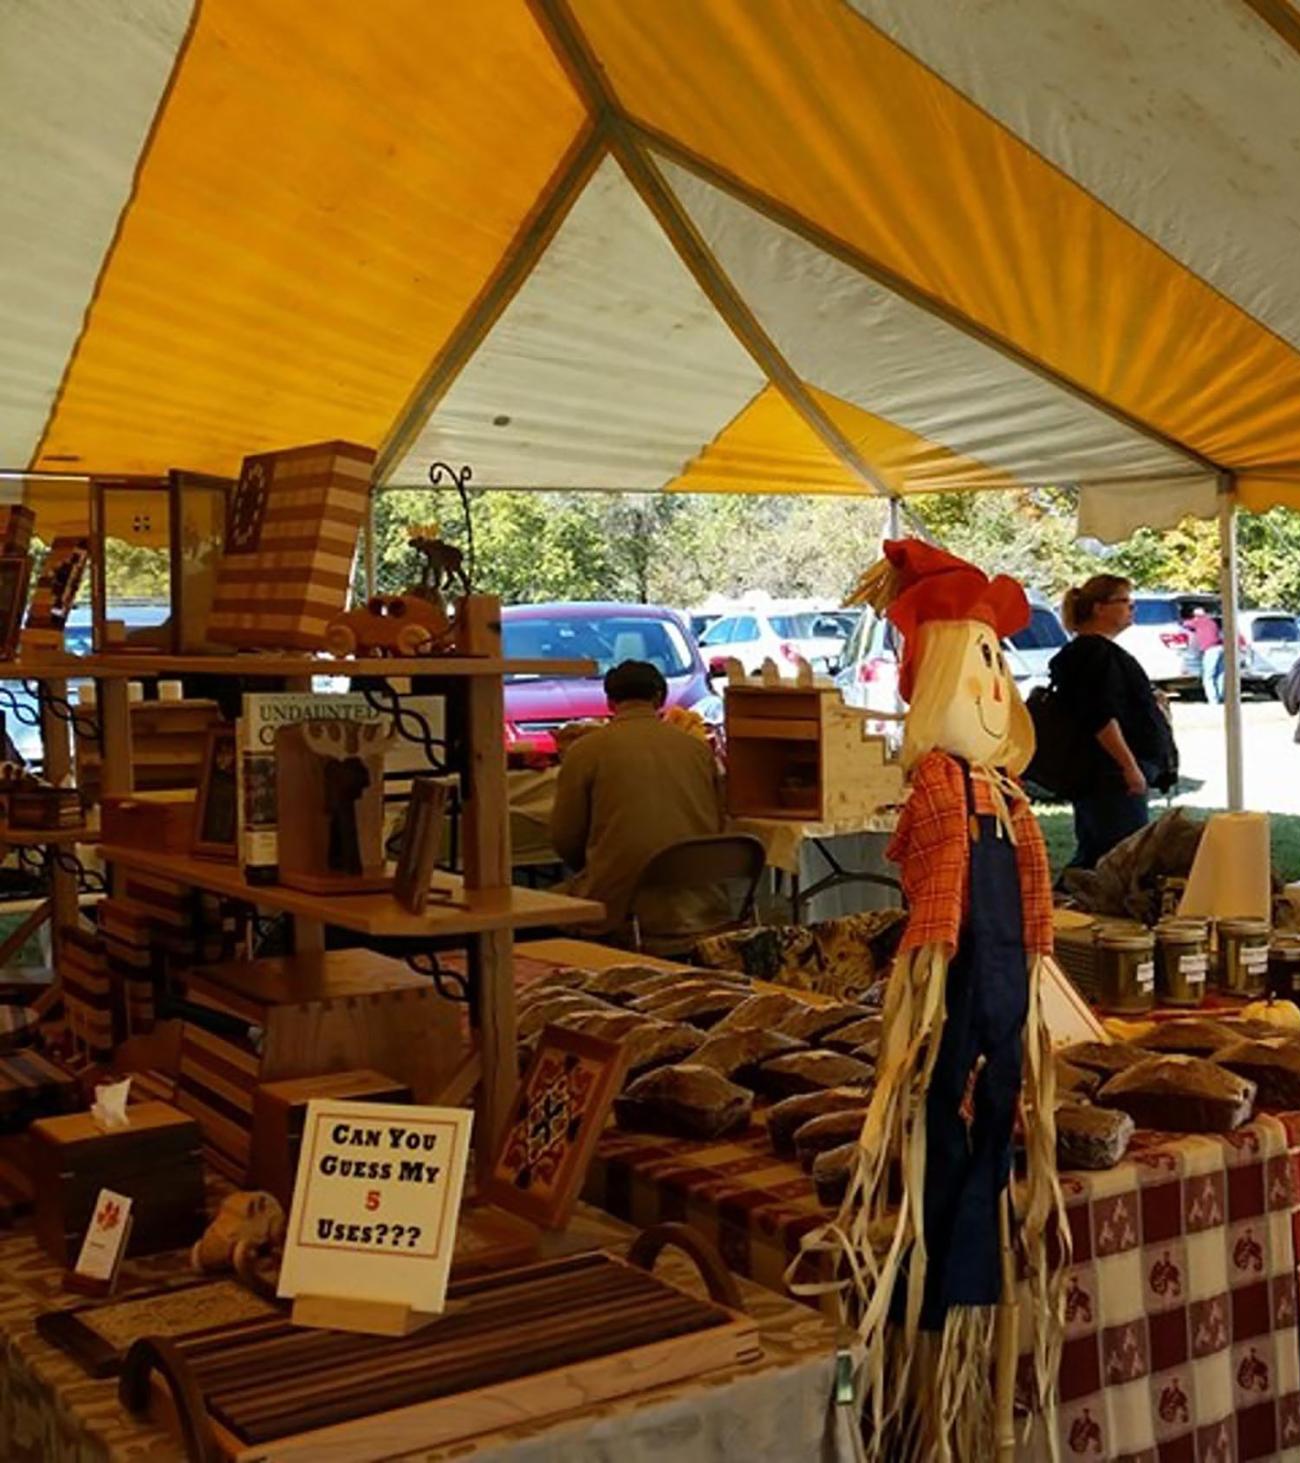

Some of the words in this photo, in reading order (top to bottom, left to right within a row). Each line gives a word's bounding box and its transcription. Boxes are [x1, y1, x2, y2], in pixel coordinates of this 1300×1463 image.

[260, 703, 381, 721] UNDAUNTED
[332, 1124, 382, 1147] CAN
[389, 1127, 437, 1150] YOU
[320, 1155, 392, 1179] GUESS
[398, 1161, 440, 1183] MY
[365, 1190, 381, 1211] 5
[317, 1219, 421, 1247] USES???
